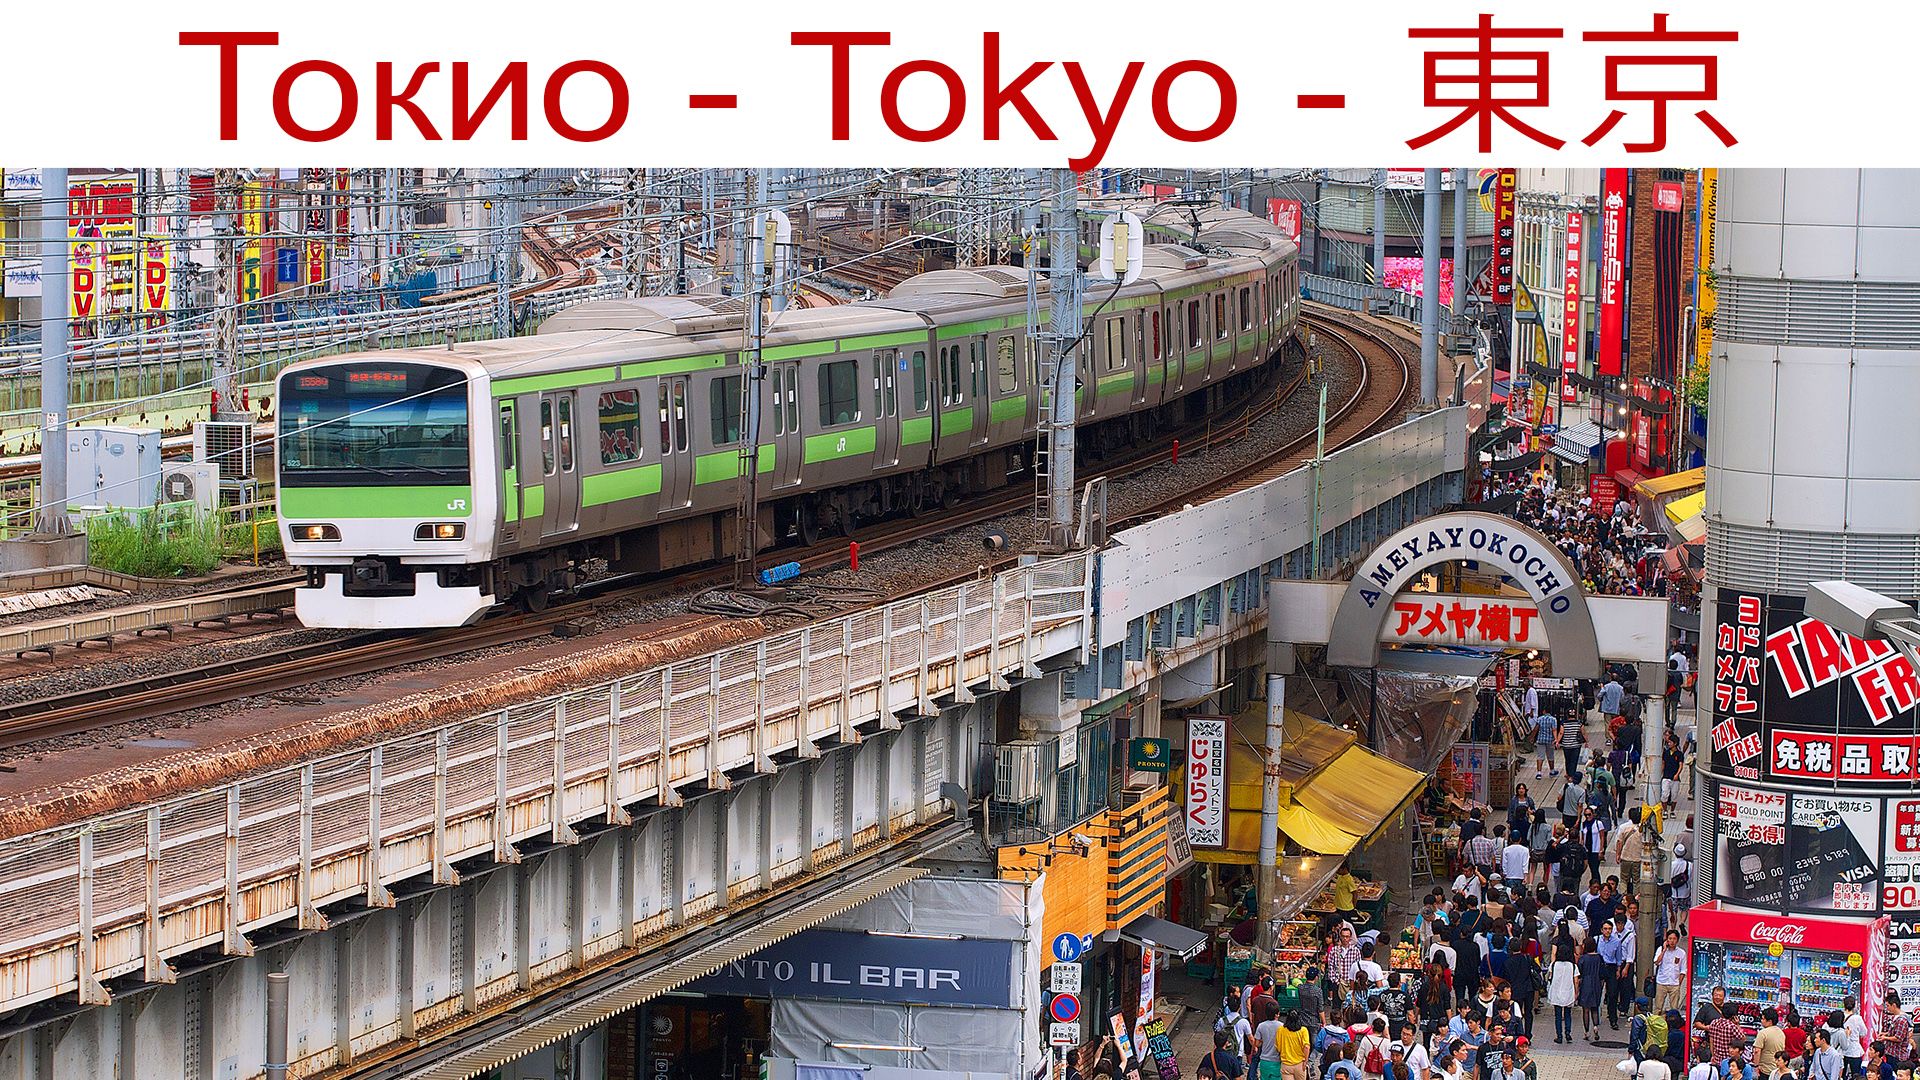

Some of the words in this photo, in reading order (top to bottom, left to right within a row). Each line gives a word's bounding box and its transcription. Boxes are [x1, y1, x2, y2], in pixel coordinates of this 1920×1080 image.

[1607, 210, 1621, 305] GAME
[1498, 285, 1511, 293] BF
[837, 437, 846, 452] JR
[447, 499, 466, 511] JR
[1358, 526, 1570, 615] AMEYAYOKOCHO
[1393, 601, 1540, 643] アメヤ横丁
[1711, 716, 1741, 753] TAX
[1726, 732, 1763, 767] FREE
[1776, 738, 1920, 776] 免税品取
[1189, 738, 1209, 826] じゅらく
[1734, 766, 1759, 780] STORE
[1719, 786, 1786, 806] ヨドバシカメラ
[1794, 798, 1873, 812] でお買い物なら
[1738, 805, 1758, 816] GOLD
[1760, 807, 1784, 819] POINT
[1792, 812, 1816, 822] CARD
[1906, 837, 1920, 849] 募
[1770, 866, 1785, 877] 00
[1796, 856, 1820, 869] 2345
[1824, 848, 1850, 861] 6789
[1838, 864, 1874, 882] VISA
[1833, 891, 1870, 901] 即時発行
[1750, 921, 1808, 944] Coca-Cola
[809, 961, 851, 985] IL
[860, 964, 962, 991] BAR
